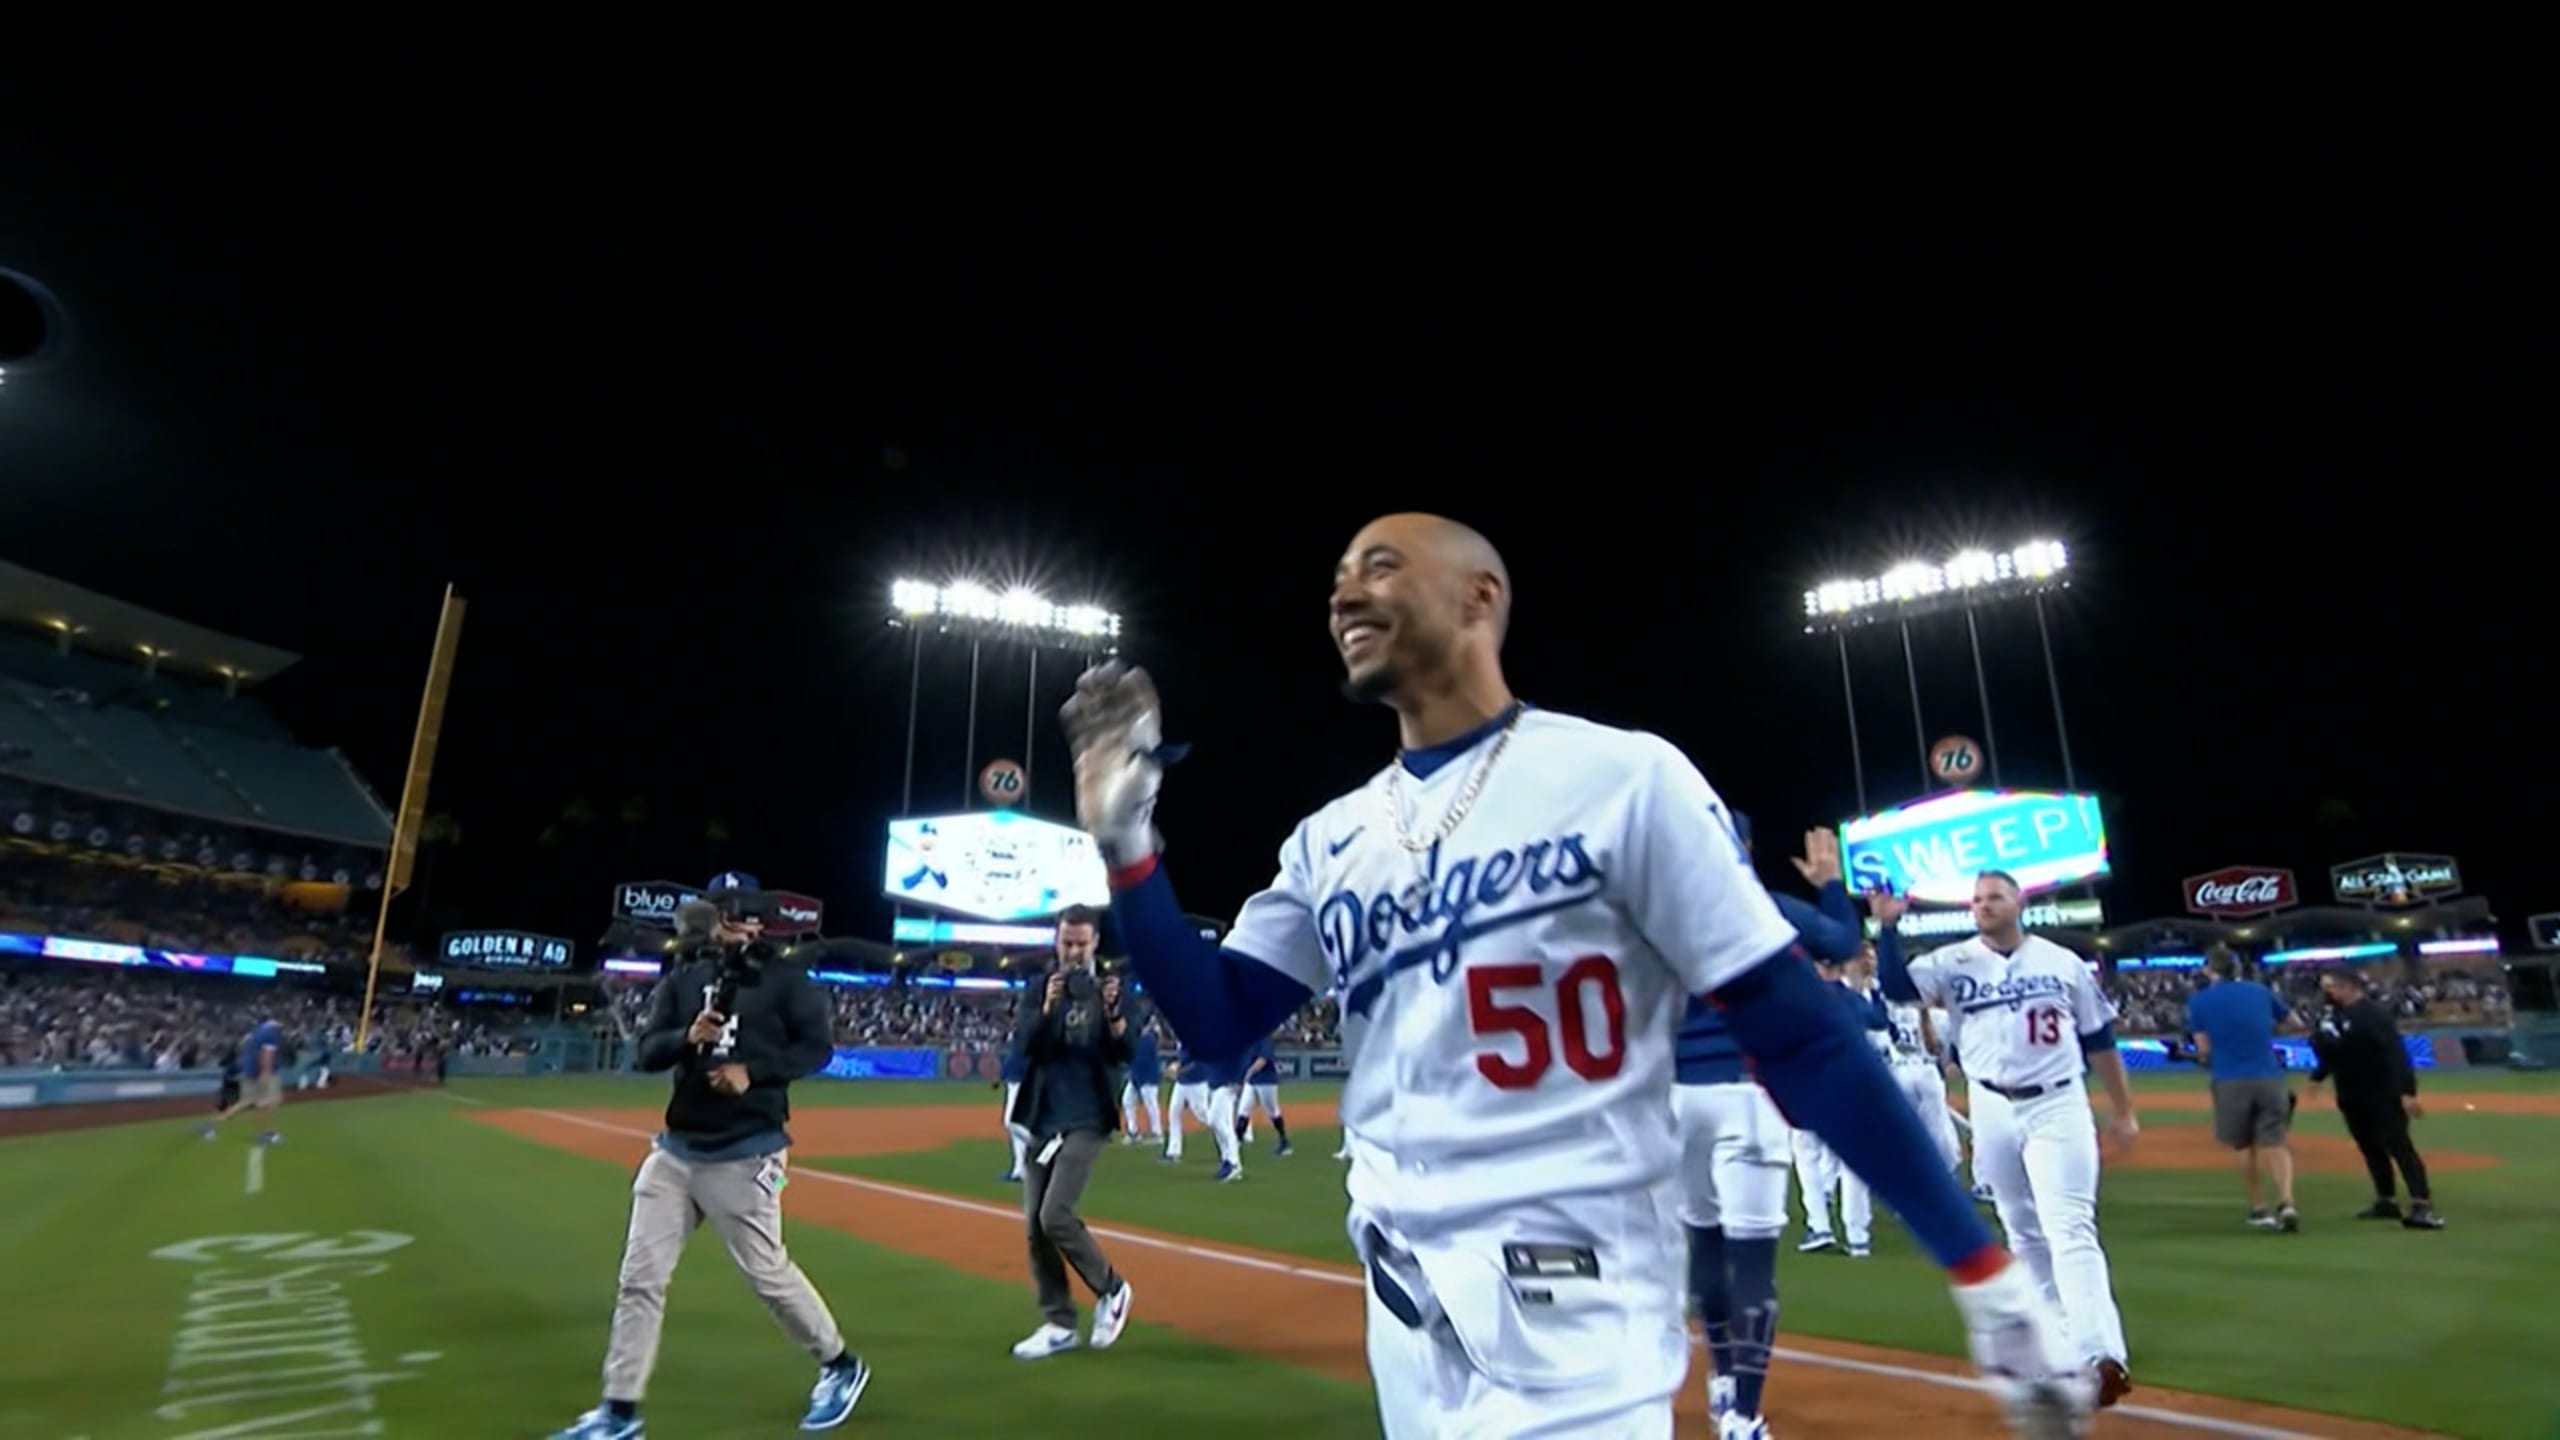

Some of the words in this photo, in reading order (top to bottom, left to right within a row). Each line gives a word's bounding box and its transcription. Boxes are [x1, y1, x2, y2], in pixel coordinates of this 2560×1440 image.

[1939, 745, 1974, 773] 76
[990, 770, 1020, 793] 76
[624, 886, 675, 911] blue
[1318, 832, 1606, 1000] Dodgers
[448, 935, 518, 957] GOLDEN
[522, 937, 567, 963] RAD
[1951, 968, 2066, 1012] Dodgers
[1466, 953, 1626, 1090] 50
[2024, 1008, 2061, 1045] 13
